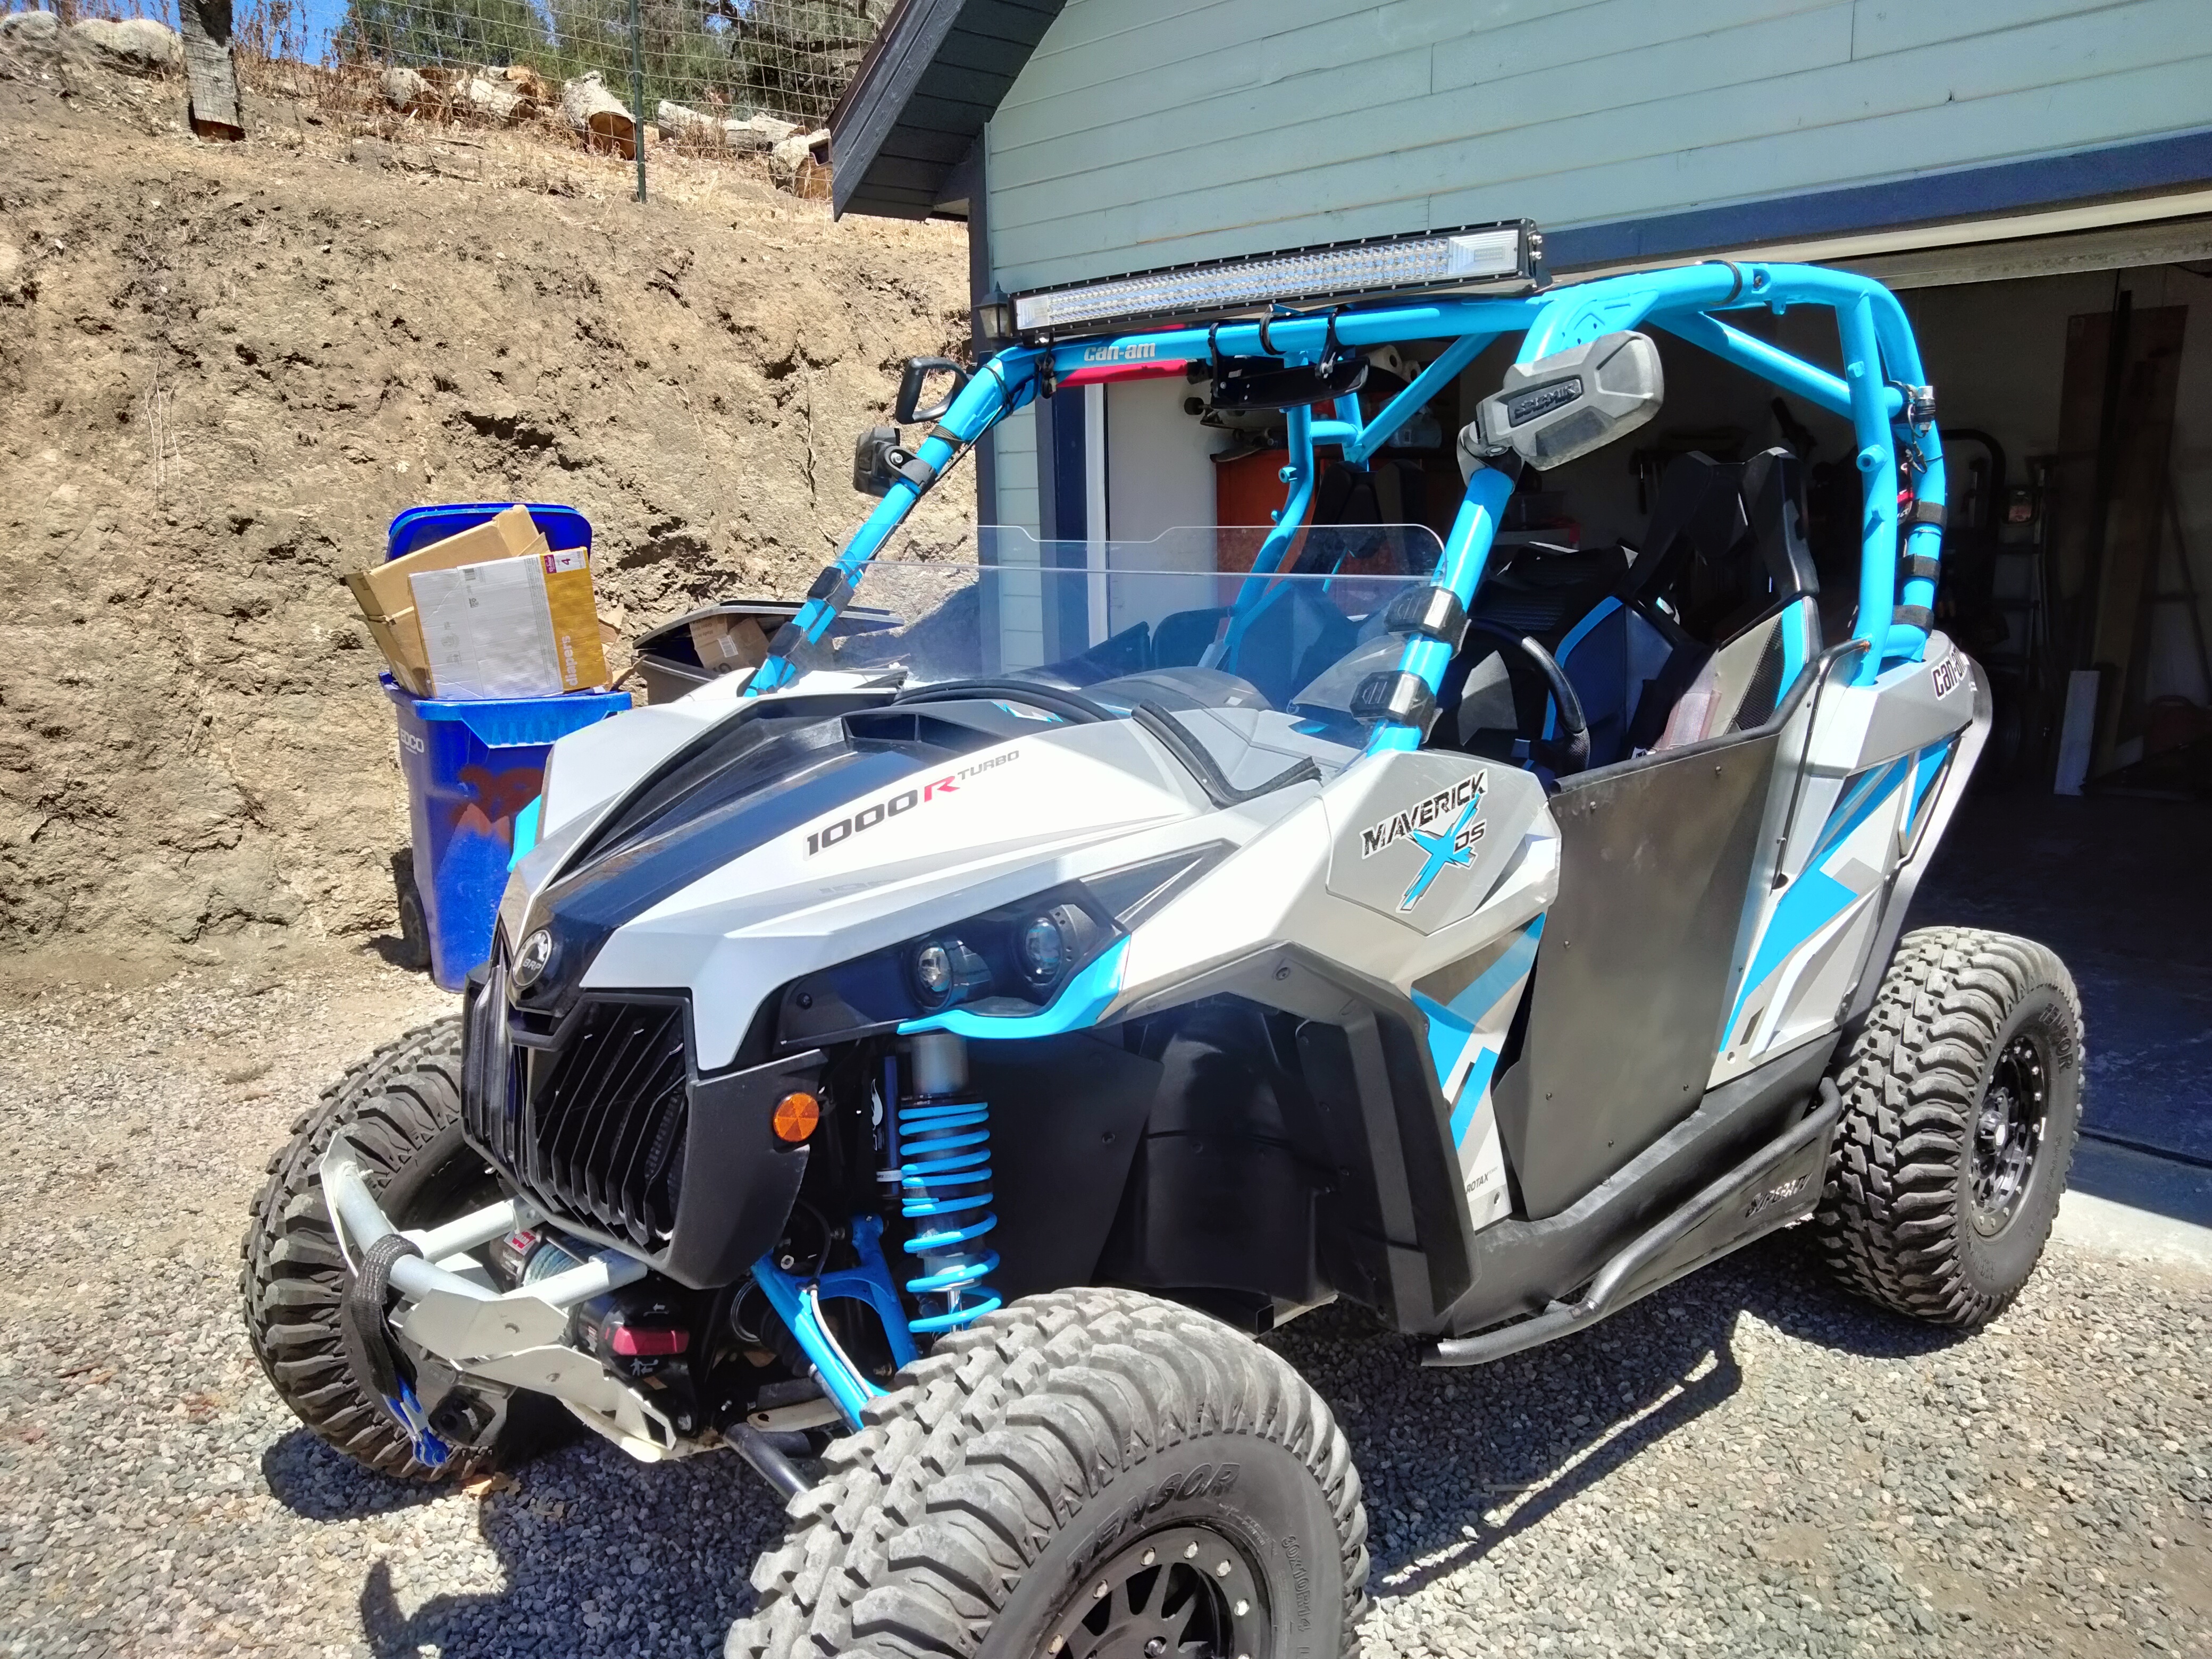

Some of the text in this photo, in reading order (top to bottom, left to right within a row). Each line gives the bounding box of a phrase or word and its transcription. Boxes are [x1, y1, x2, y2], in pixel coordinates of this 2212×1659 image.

[1084, 342, 1155, 362] can-am
[562, 635, 579, 686] diapers
[400, 727, 424, 753] EDCO
[957, 750, 1020, 781] TURBO
[1361, 771, 1487, 857] MAVERICK
[523, 958, 542, 971] BRP
[1465, 1173, 1488, 1195] ROTAX
